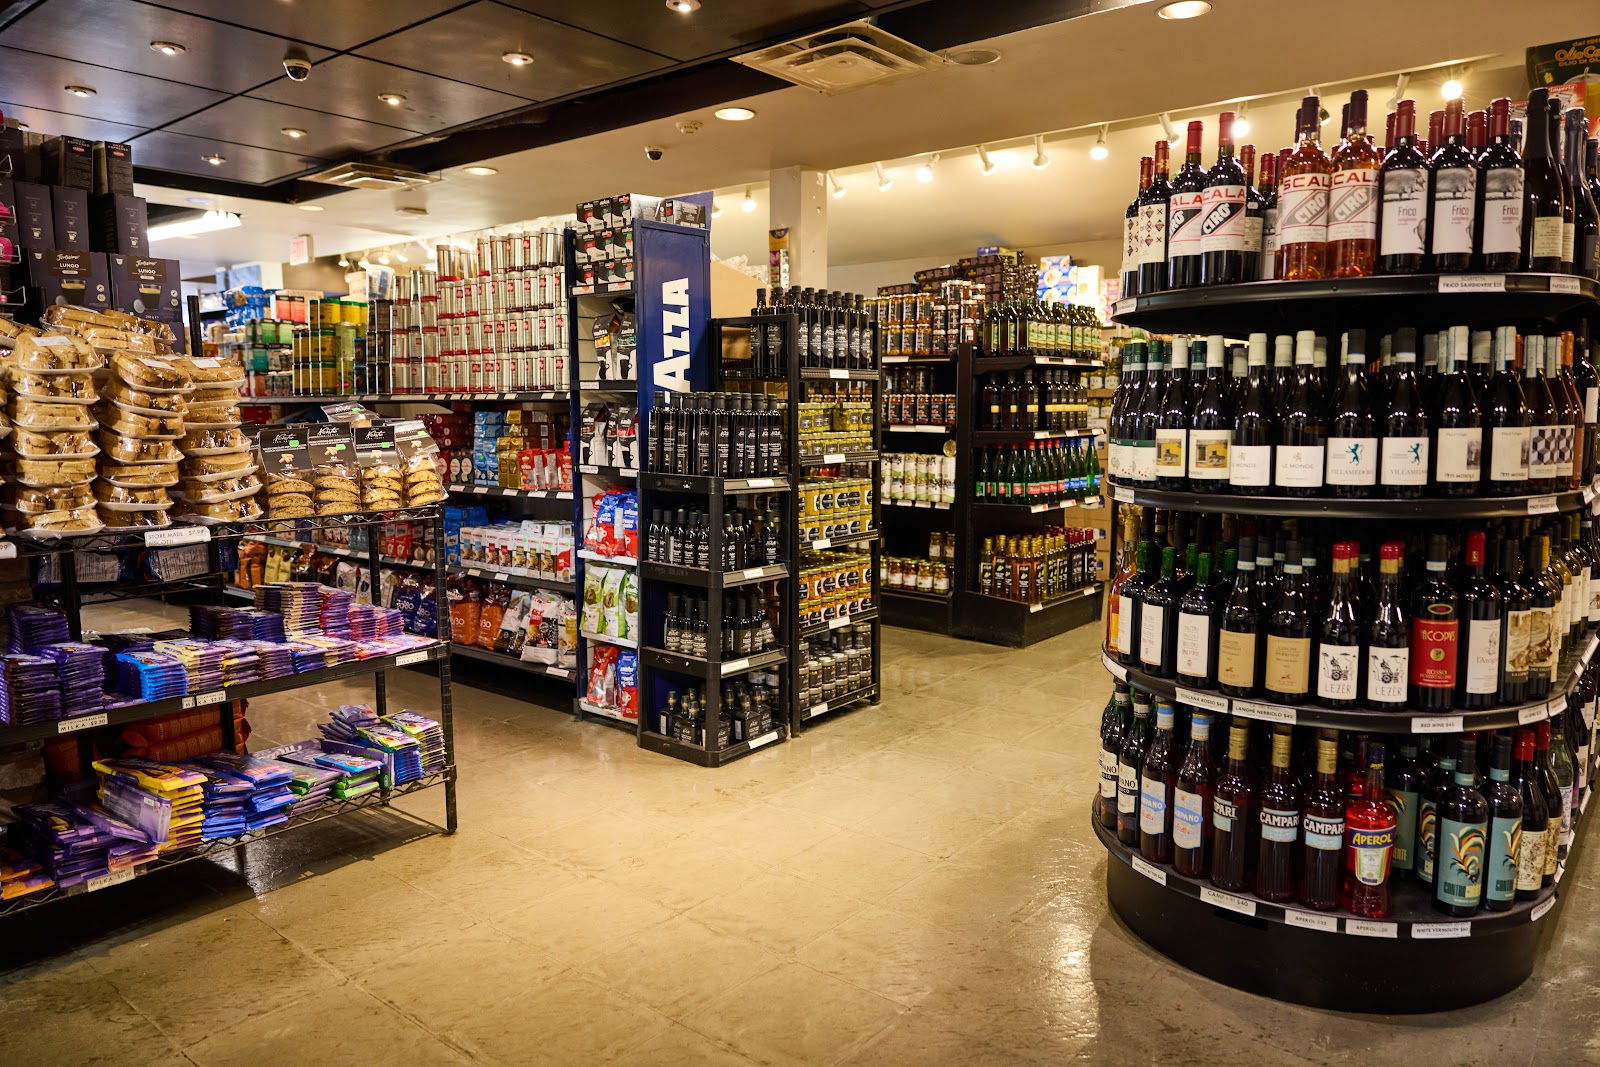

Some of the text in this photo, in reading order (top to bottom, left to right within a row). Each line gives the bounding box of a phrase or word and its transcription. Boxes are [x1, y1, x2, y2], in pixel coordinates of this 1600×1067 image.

[1398, 206, 1417, 216] Frico
[1452, 205, 1470, 216] Frico
[1502, 205, 1520, 216] Frico
[653, 278, 690, 393] AZZA
[1180, 694, 1200, 702] TOSCANA
[1201, 698, 1216, 706] ROSSO
[1236, 706, 1256, 714] LANGHE
[1256, 710, 1282, 718] NEBBIOLO
[60, 723, 86, 732] MILKA
[1352, 832, 1392, 846] APEROL
[90, 877, 112, 886] MILKA
[1208, 890, 1236, 902] CAMPARI
[1296, 916, 1316, 924] APEROL
